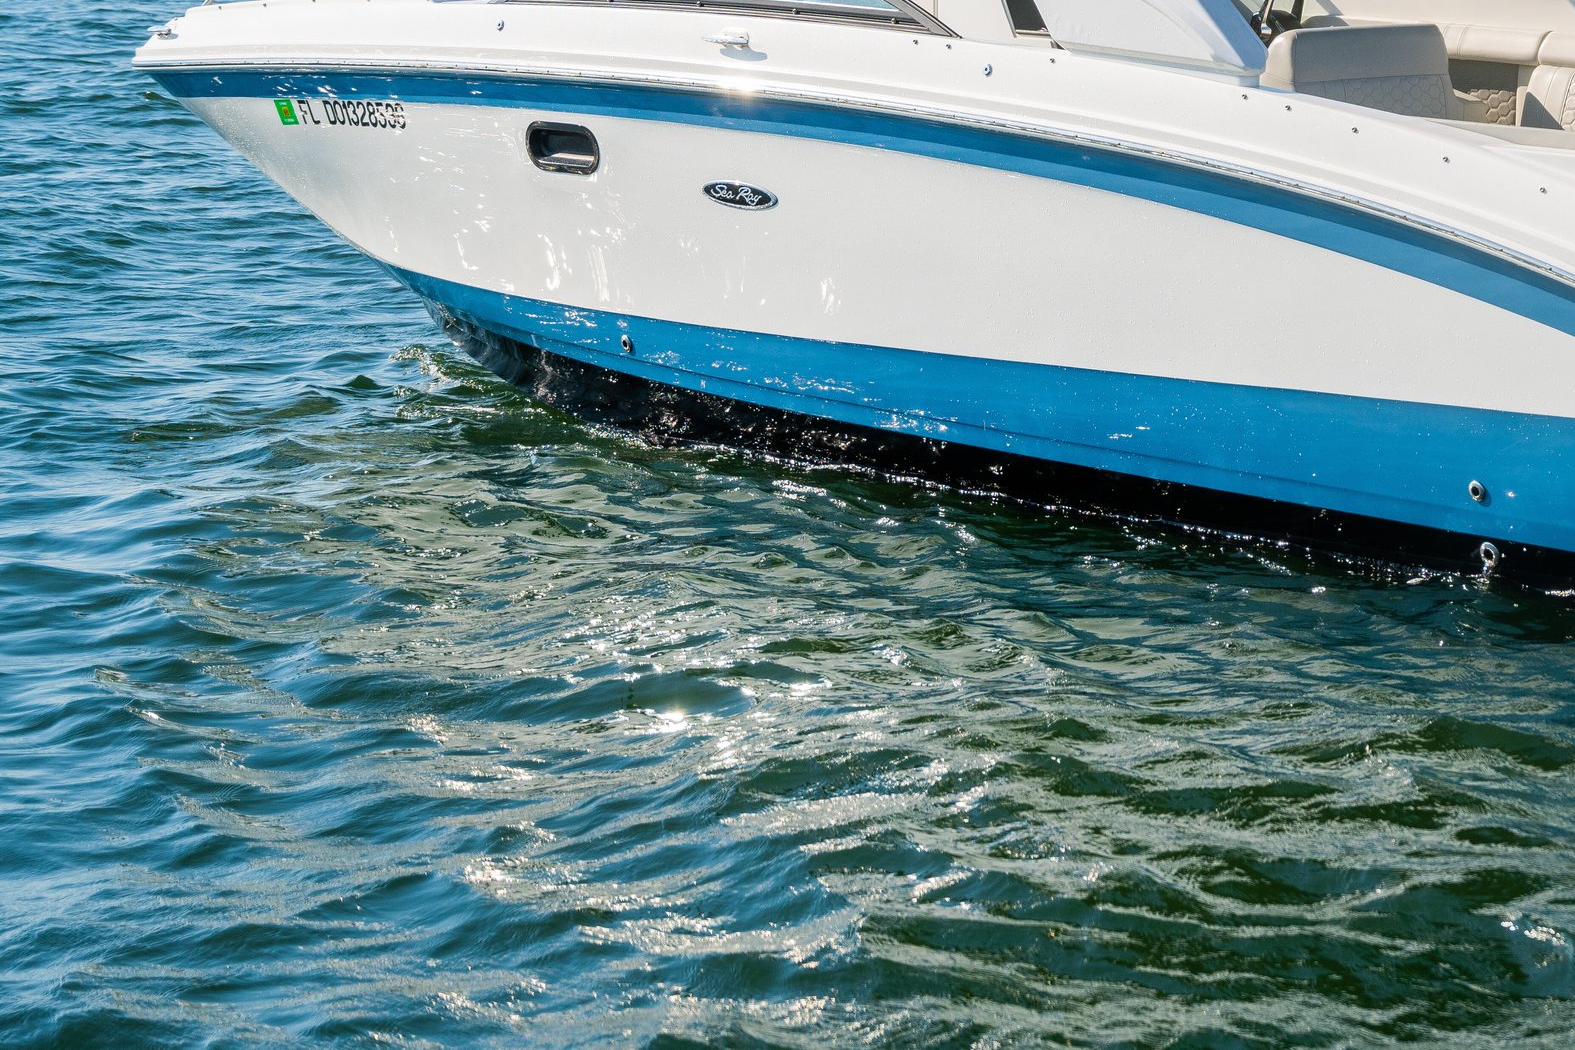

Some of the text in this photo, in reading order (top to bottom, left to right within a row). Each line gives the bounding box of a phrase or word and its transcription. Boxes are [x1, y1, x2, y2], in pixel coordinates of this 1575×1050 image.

[297, 99, 321, 125] FL
[710, 184, 762, 206] Sea Ray
